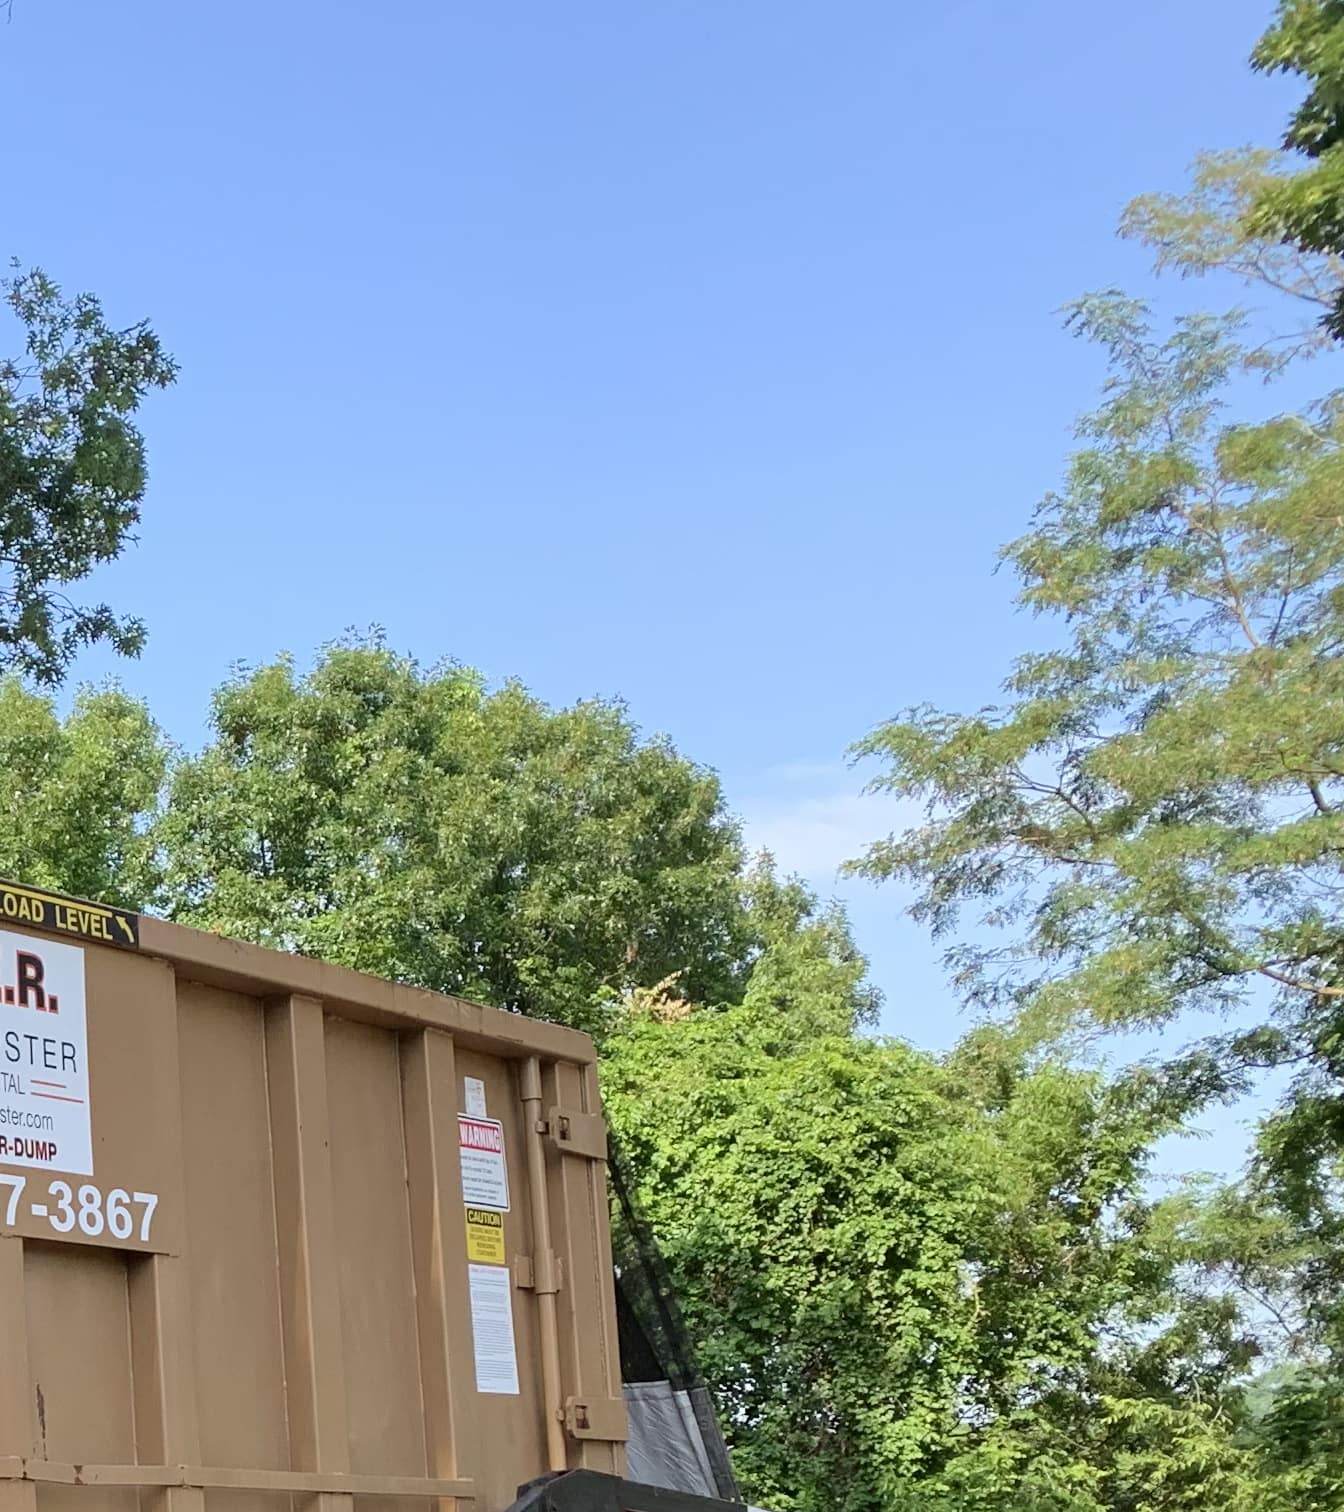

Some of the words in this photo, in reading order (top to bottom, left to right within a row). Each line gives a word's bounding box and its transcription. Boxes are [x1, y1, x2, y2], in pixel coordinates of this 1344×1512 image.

[55, 905, 113, 940] LEVEL
[459, 1123, 501, 1151] WARNING
[468, 1209, 501, 1227] CAUTION
